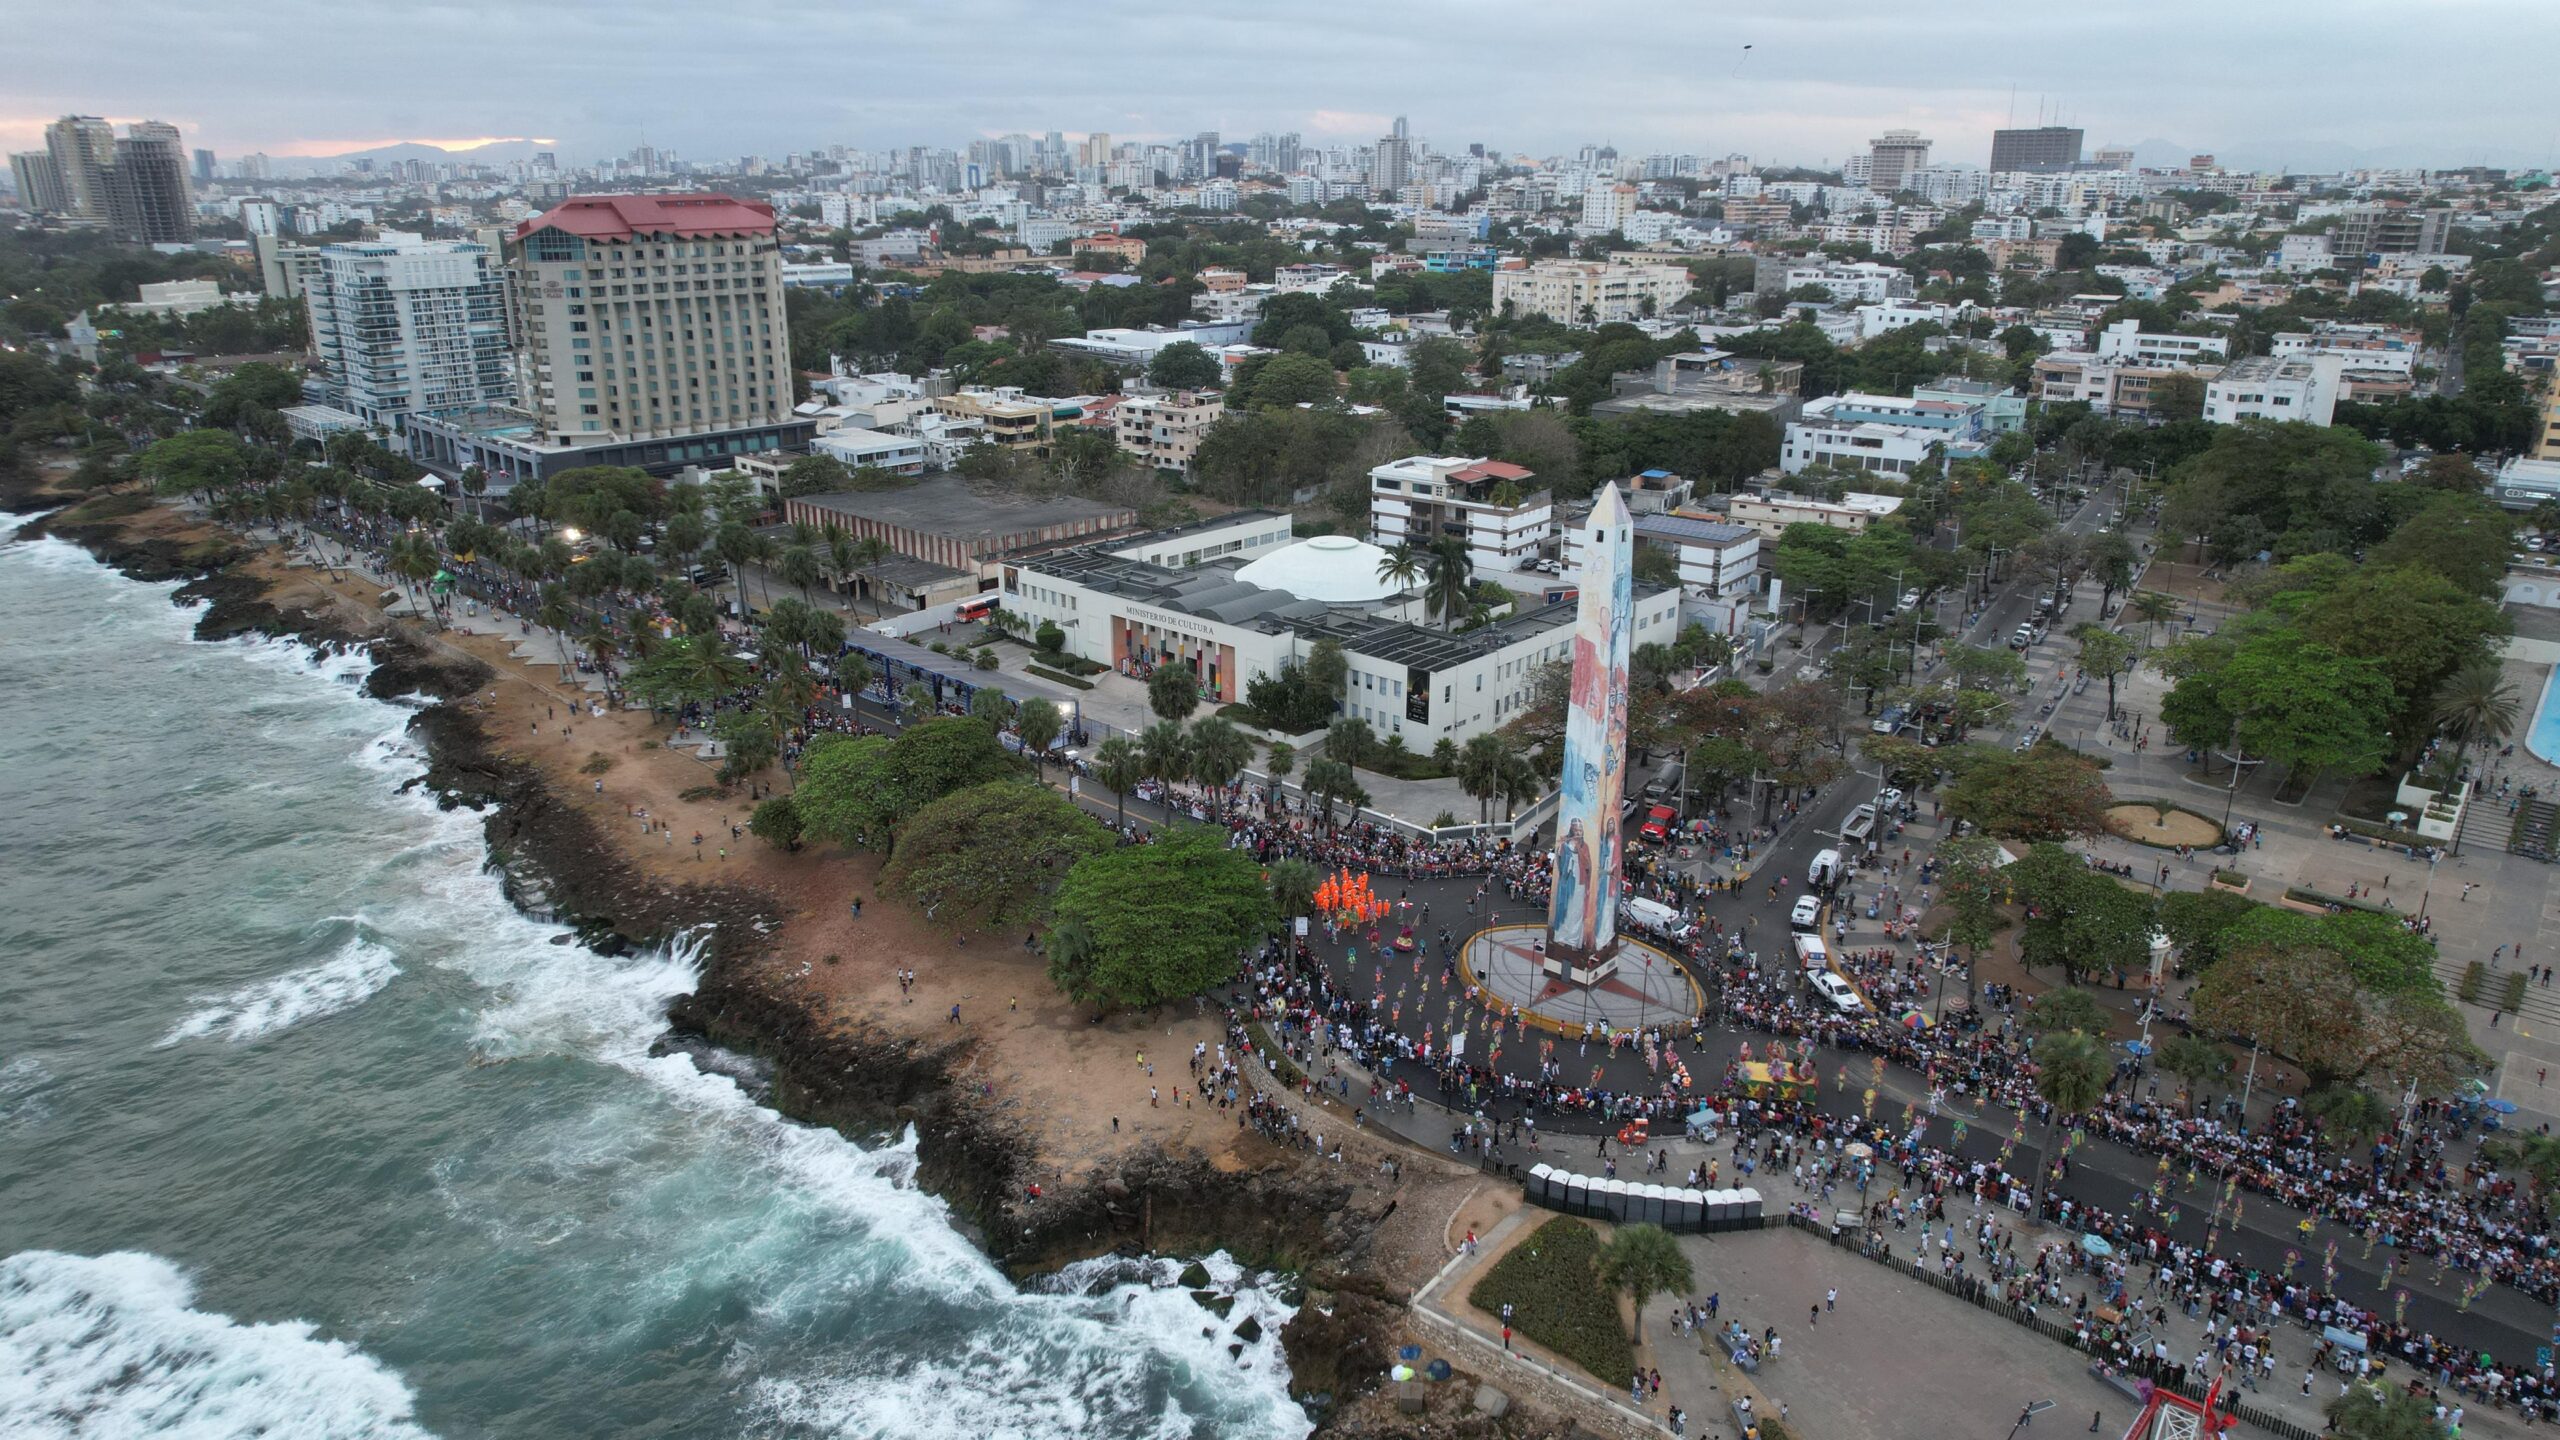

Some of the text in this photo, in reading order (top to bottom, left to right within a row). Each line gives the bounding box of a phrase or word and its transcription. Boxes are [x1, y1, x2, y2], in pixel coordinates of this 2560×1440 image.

[1126, 606, 1214, 635] MINISTERIO DE CULTURA
